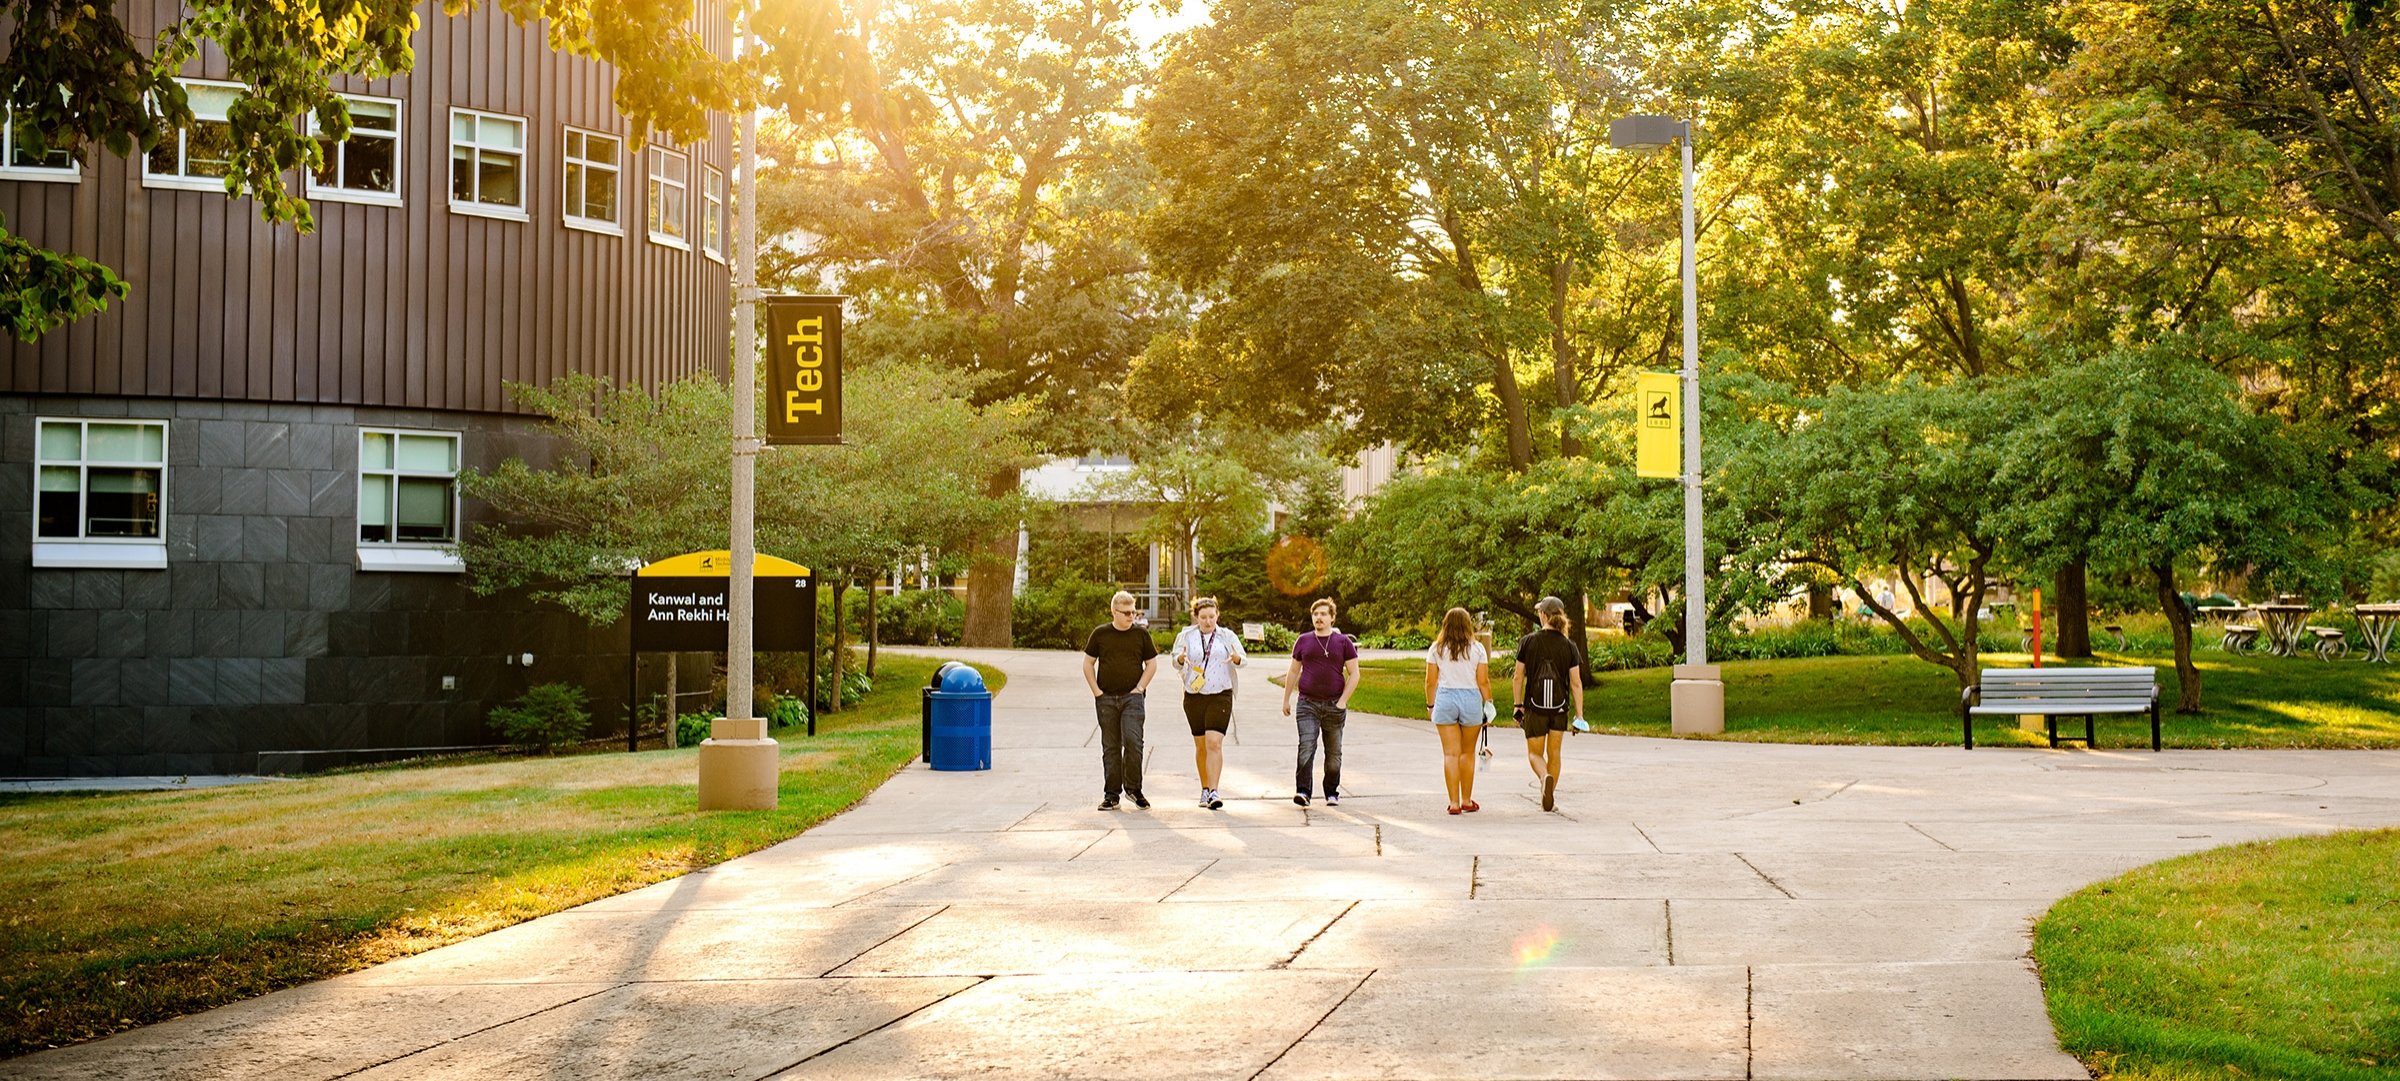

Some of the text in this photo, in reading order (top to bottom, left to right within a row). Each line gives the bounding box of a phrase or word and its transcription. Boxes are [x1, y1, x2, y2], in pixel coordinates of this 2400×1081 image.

[786, 316, 823, 423] Tech
[795, 579, 807, 588] 28
[648, 592, 724, 605] Kanwal and
[647, 608, 674, 621] Ann
[677, 608, 713, 621] Rekhi
